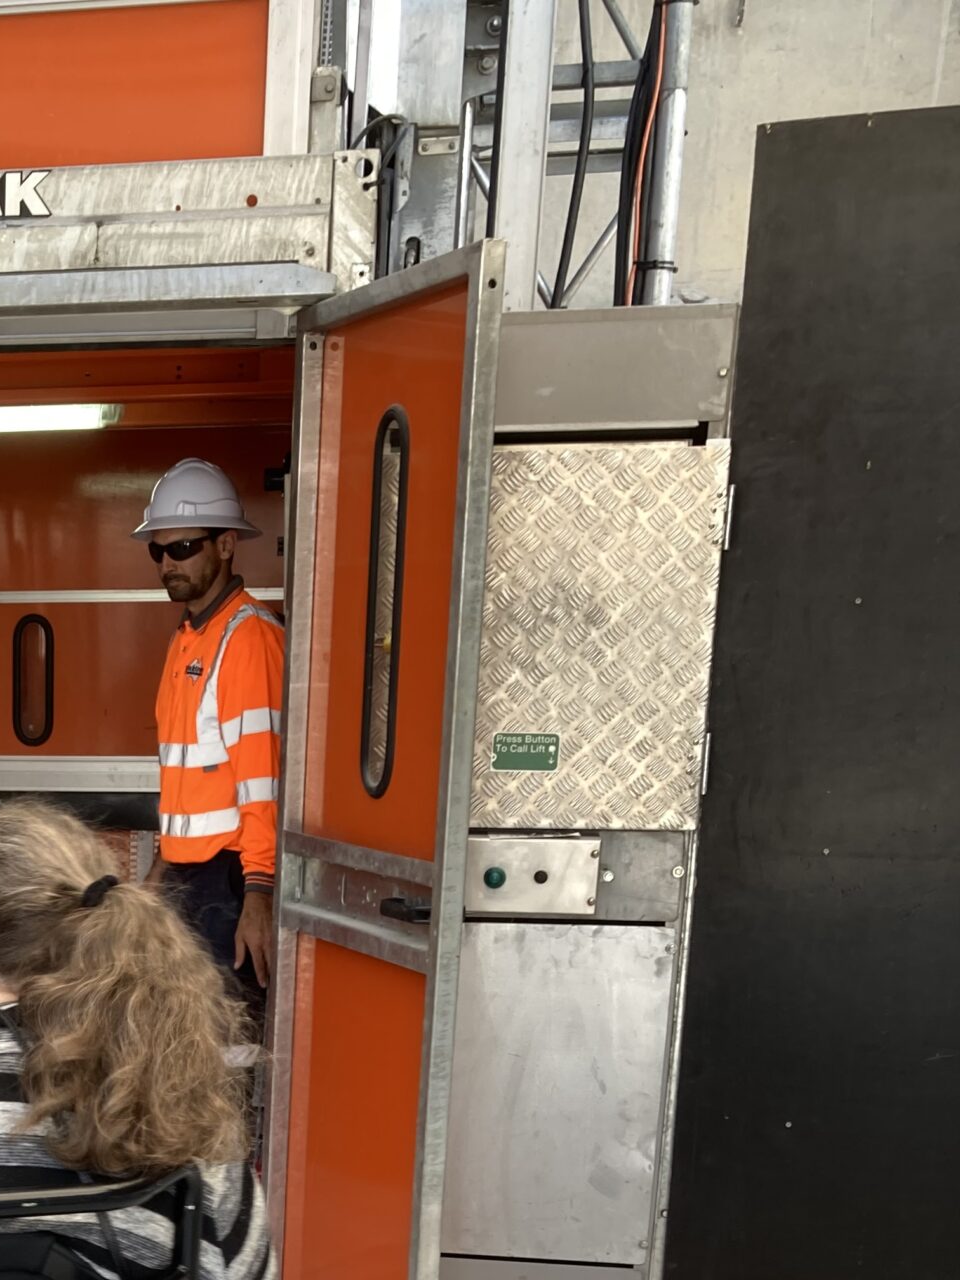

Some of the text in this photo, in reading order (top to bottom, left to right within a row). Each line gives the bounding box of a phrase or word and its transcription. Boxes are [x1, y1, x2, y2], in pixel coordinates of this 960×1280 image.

[496, 734, 556, 744] Press Button
[495, 744, 546, 753] To Call Lift
